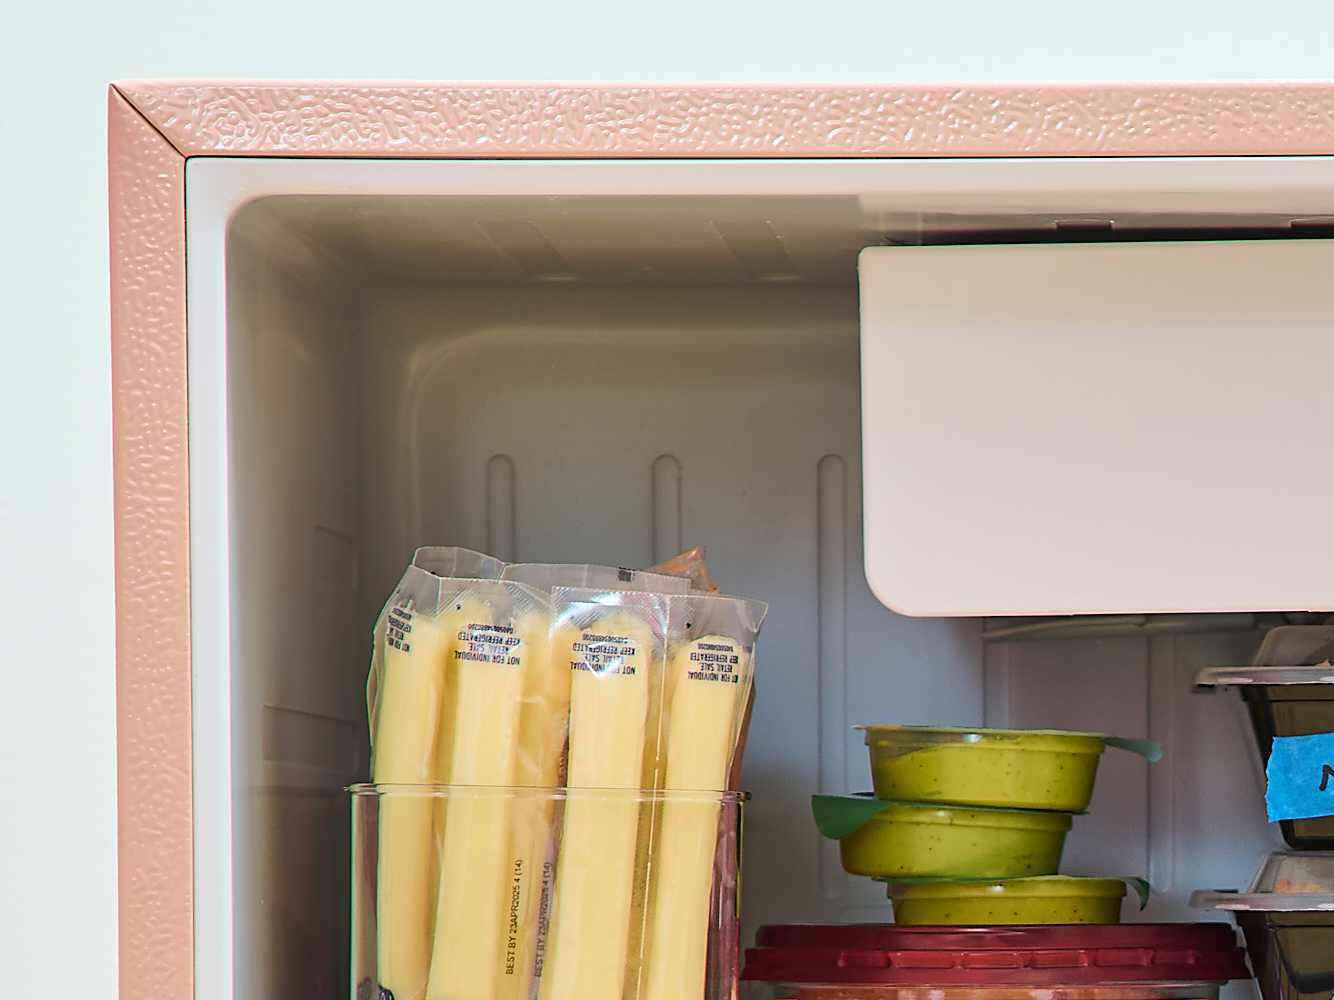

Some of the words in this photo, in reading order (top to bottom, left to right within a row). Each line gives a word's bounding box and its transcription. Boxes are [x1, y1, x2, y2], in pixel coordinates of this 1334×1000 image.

[454, 650, 491, 662] INDIVIDUAL
[619, 647, 635, 656] KEEP
[492, 655, 504, 664] FOR
[508, 656, 520, 665] NOT
[622, 665, 635, 675] NOT
[507, 936, 516, 948] BY
[505, 952, 515, 975] BEST
